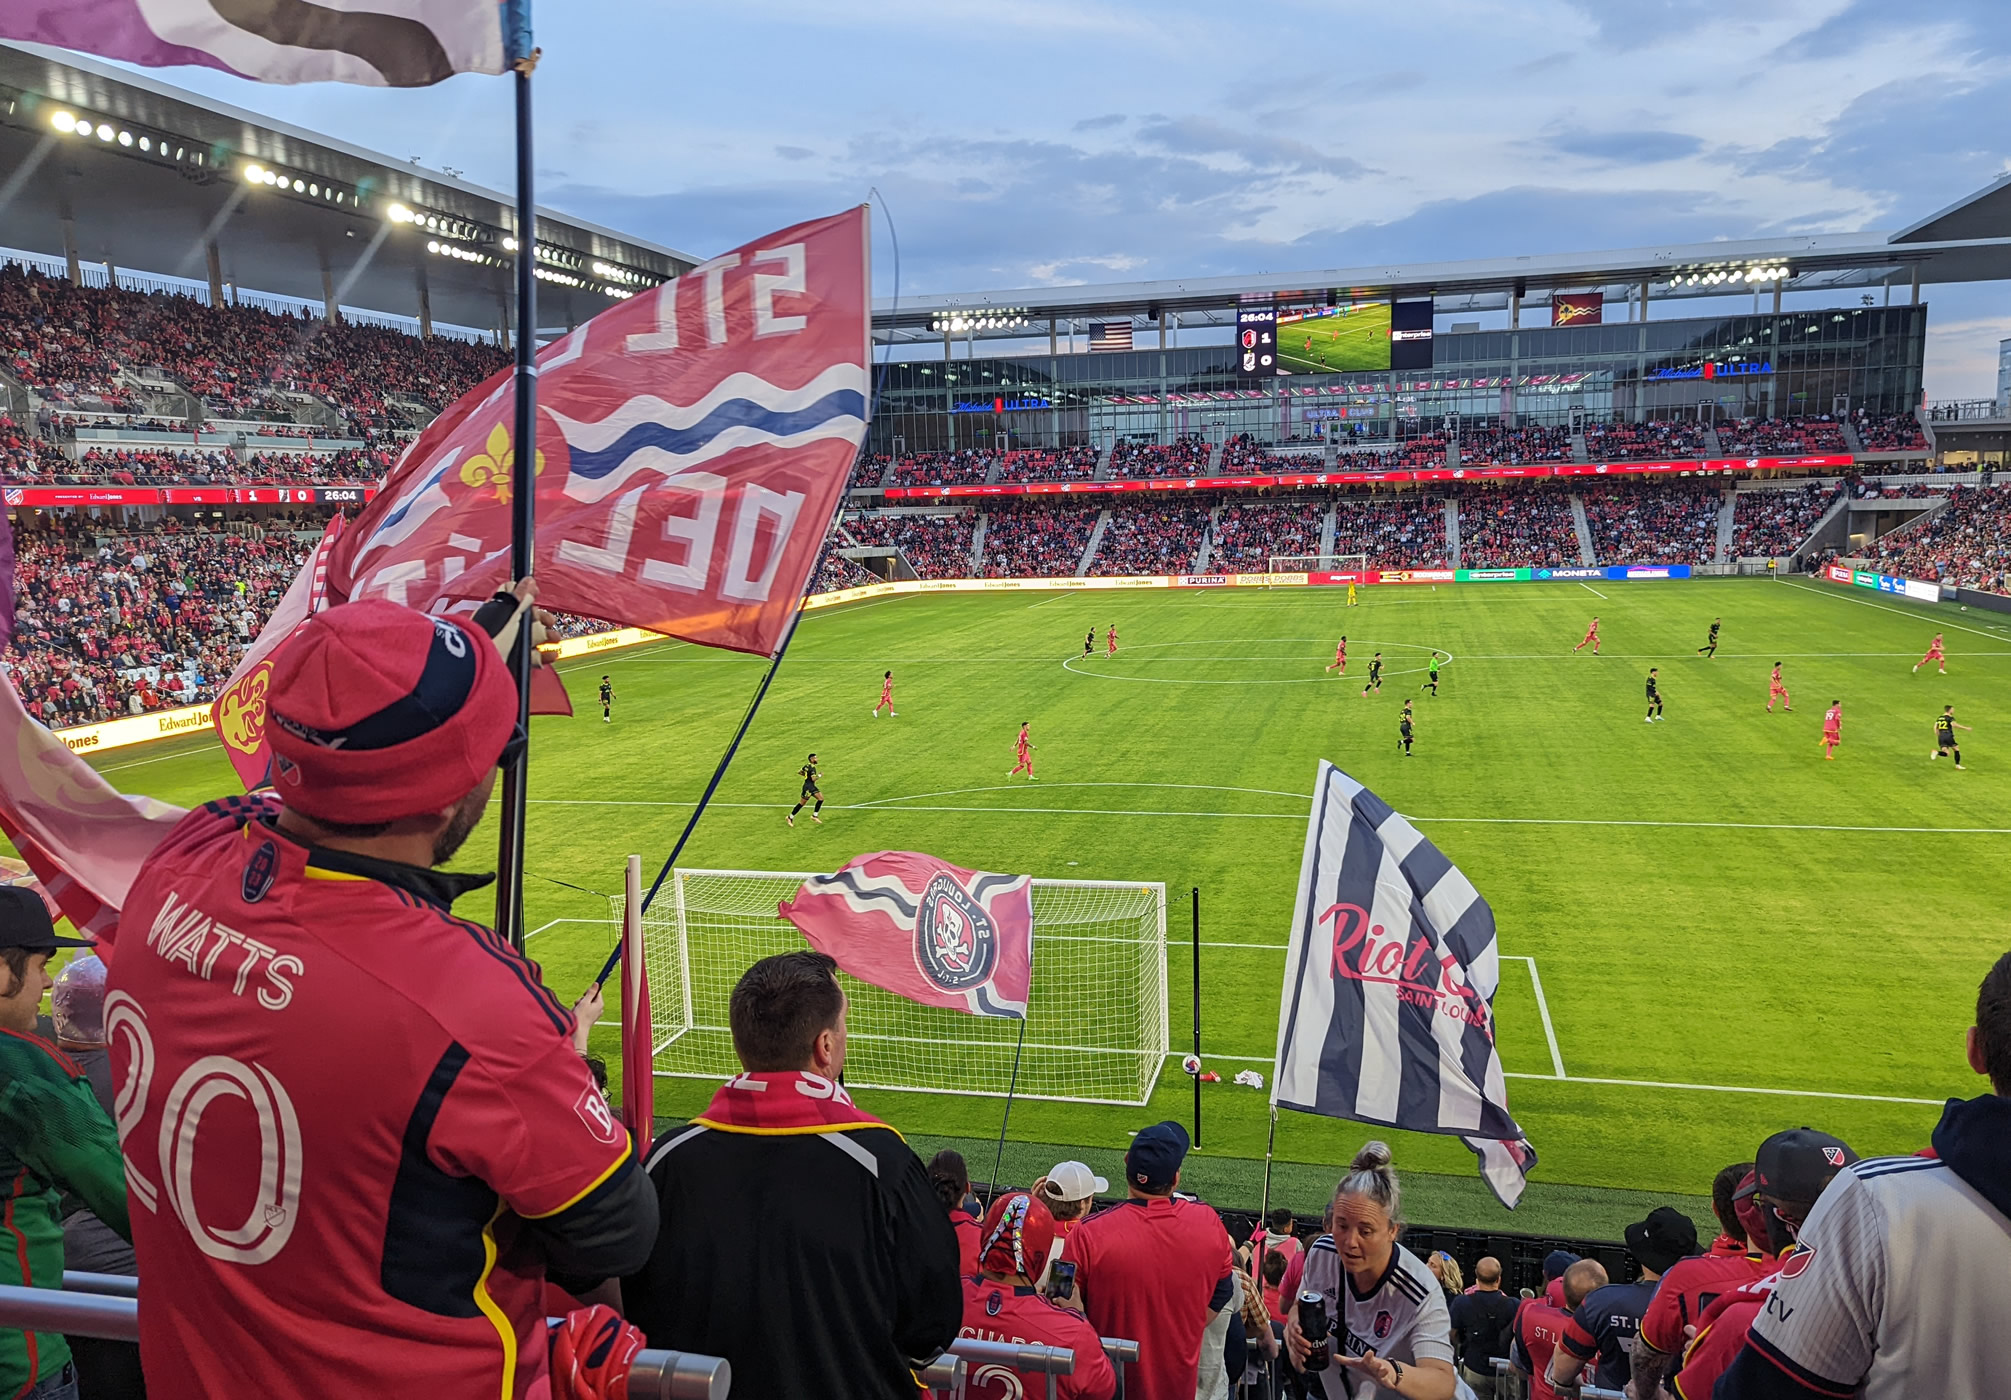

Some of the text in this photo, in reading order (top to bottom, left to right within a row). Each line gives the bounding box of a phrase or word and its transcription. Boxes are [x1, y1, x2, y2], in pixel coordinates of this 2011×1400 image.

[1240, 312, 1273, 322] 26:04
[1261, 332, 1271, 343] 1
[1393, 330, 1431, 340] nterprise
[1260, 355, 1272, 366] 0
[1717, 362, 1771, 376] ULTRA
[1005, 399, 1048, 410] ULTRA
[1306, 407, 1374, 418] ULTRA CLUB
[248, 491, 257, 501] 1
[297, 491, 307, 501] 0
[325, 491, 356, 500] 26:04
[1552, 569, 1602, 577] MONETA
[1189, 577, 1224, 585] PURINA
[1319, 902, 1434, 988] Riot
[146, 891, 305, 1011] WATTS
[102, 988, 303, 1266] 20
[1767, 1290, 1794, 1323] tv
[1610, 1315, 1631, 1329] ST.
[1534, 1326, 1549, 1342] ST.
